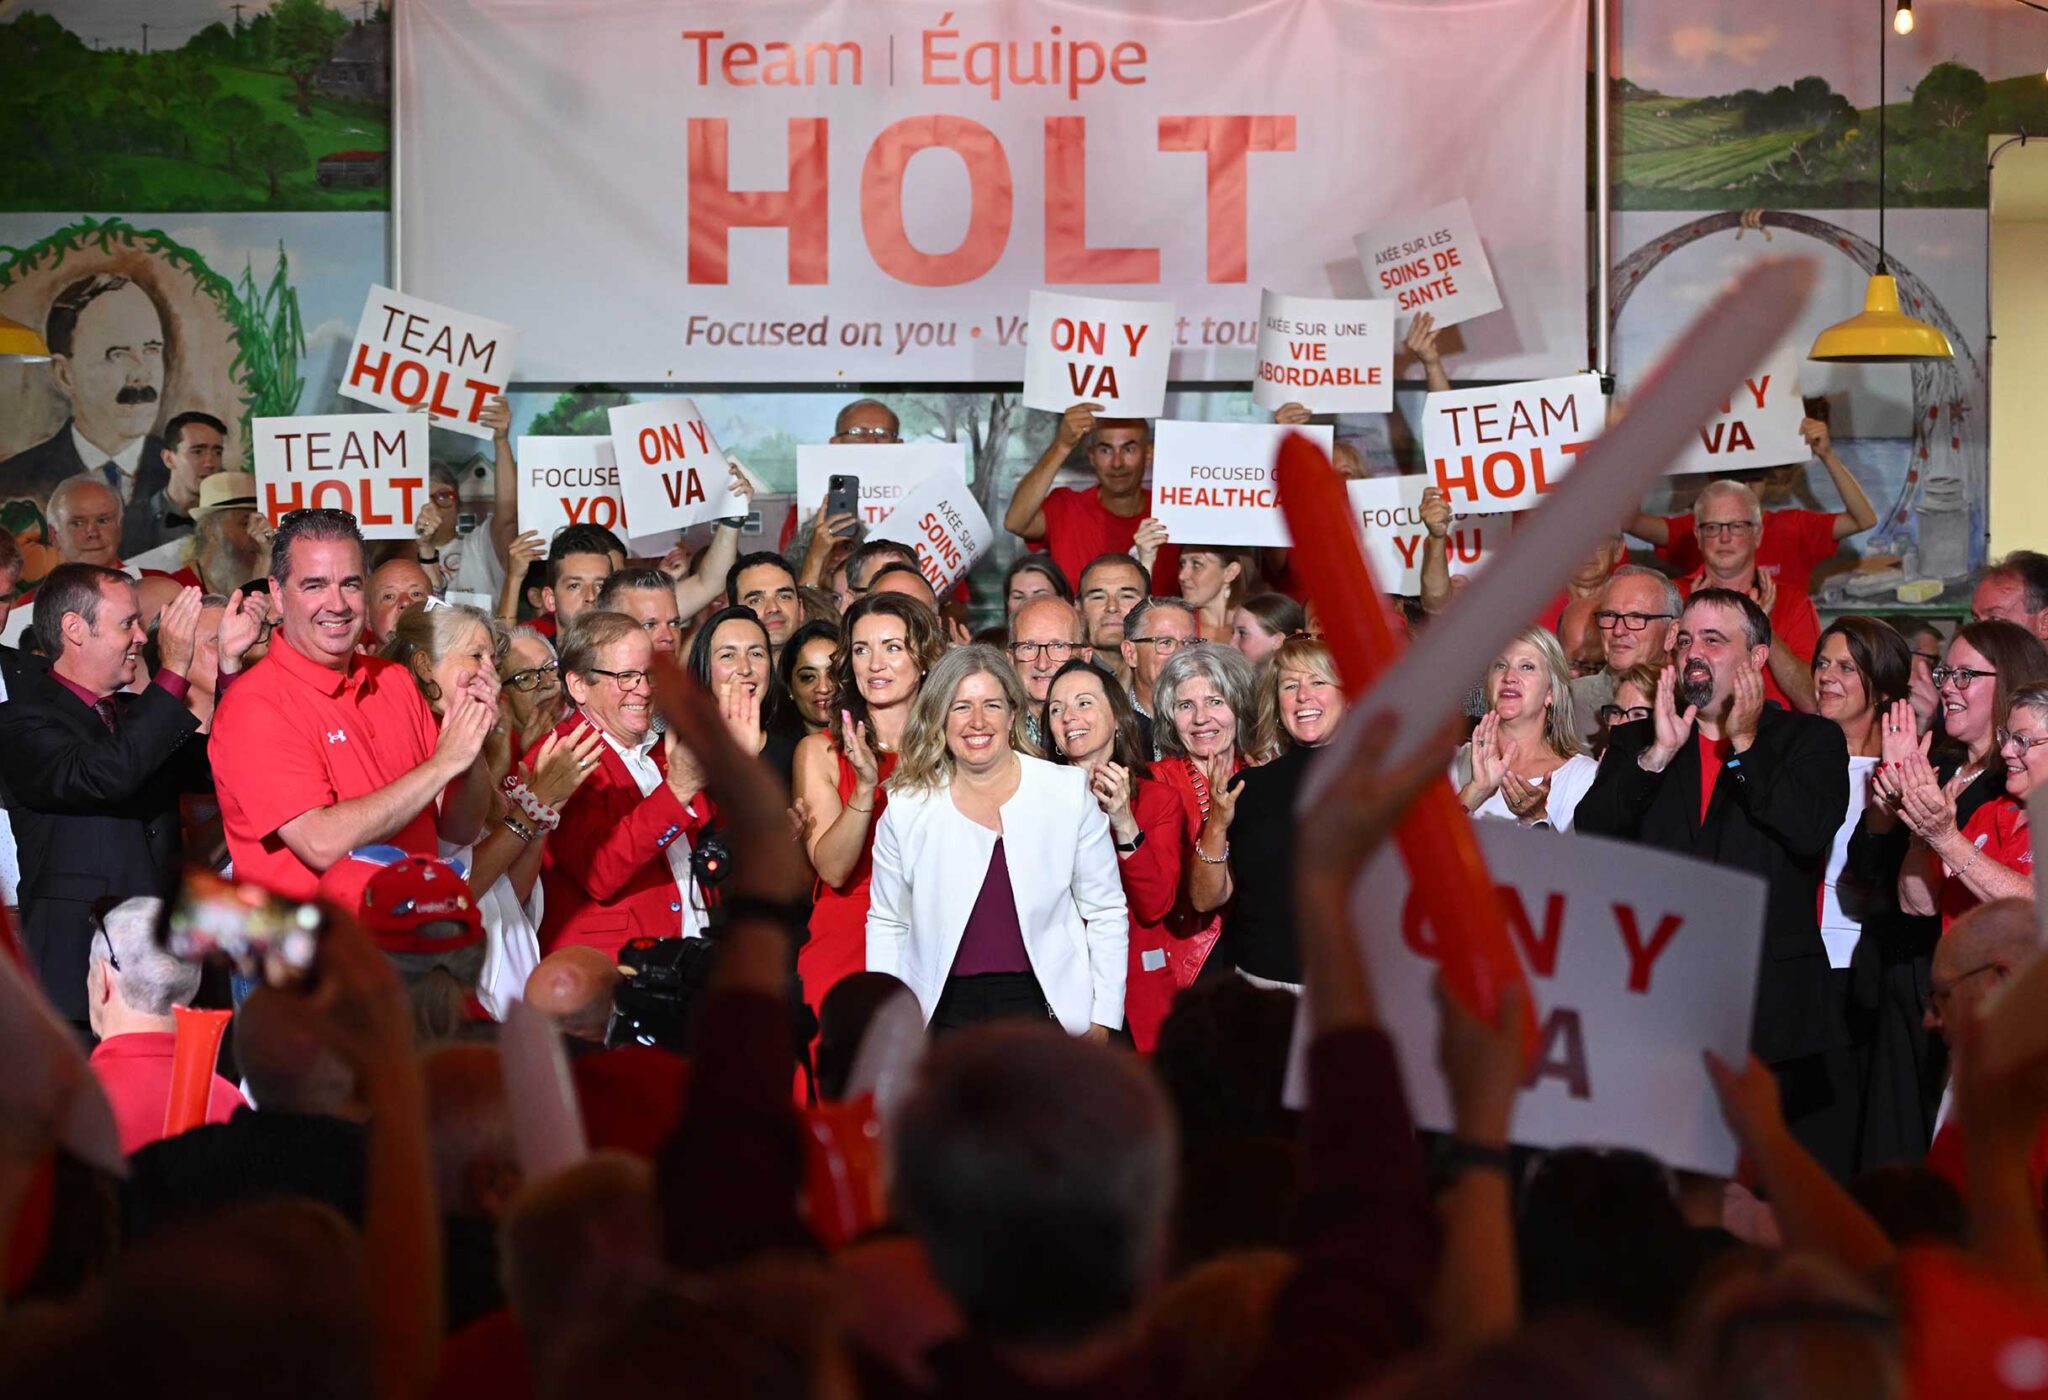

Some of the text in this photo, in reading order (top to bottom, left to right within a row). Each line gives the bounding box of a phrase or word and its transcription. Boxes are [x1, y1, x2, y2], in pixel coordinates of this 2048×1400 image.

[682, 12, 1148, 101] Team Équipe
[687, 115, 1296, 287] HOLT
[1374, 229, 1453, 266] AXÉE SUR LES
[1380, 247, 1462, 290] SOINS DE
[1398, 272, 1459, 311] SANTÉ
[383, 304, 497, 375] TEAM
[686, 315, 829, 347] Focused
[840, 322, 882, 347] on
[895, 322, 957, 355] you
[1202, 317, 1258, 346] tou
[1051, 317, 1106, 356] ON
[1122, 324, 1149, 358] Y
[1296, 322, 1327, 336] SUR
[1335, 323, 1367, 337] UNE
[1289, 341, 1327, 362] VIE
[349, 343, 501, 424] HOLT
[1067, 362, 1120, 399] VA
[1258, 360, 1382, 387] ABORDABLE
[1440, 394, 1579, 447] TEAM
[1698, 420, 1756, 454] VA
[274, 430, 407, 473] TEAM
[638, 419, 709, 465] ON Y
[531, 466, 621, 488] FOCUSE
[661, 468, 706, 509] VA
[1190, 466, 1265, 482] FOCUSED
[265, 477, 424, 530] HOLT
[560, 495, 628, 530] YO
[1160, 486, 1283, 509] HEALTHCA
[918, 512, 962, 570] SOINS
[914, 542, 950, 593] SANT
[1610, 902, 1685, 995] Y
